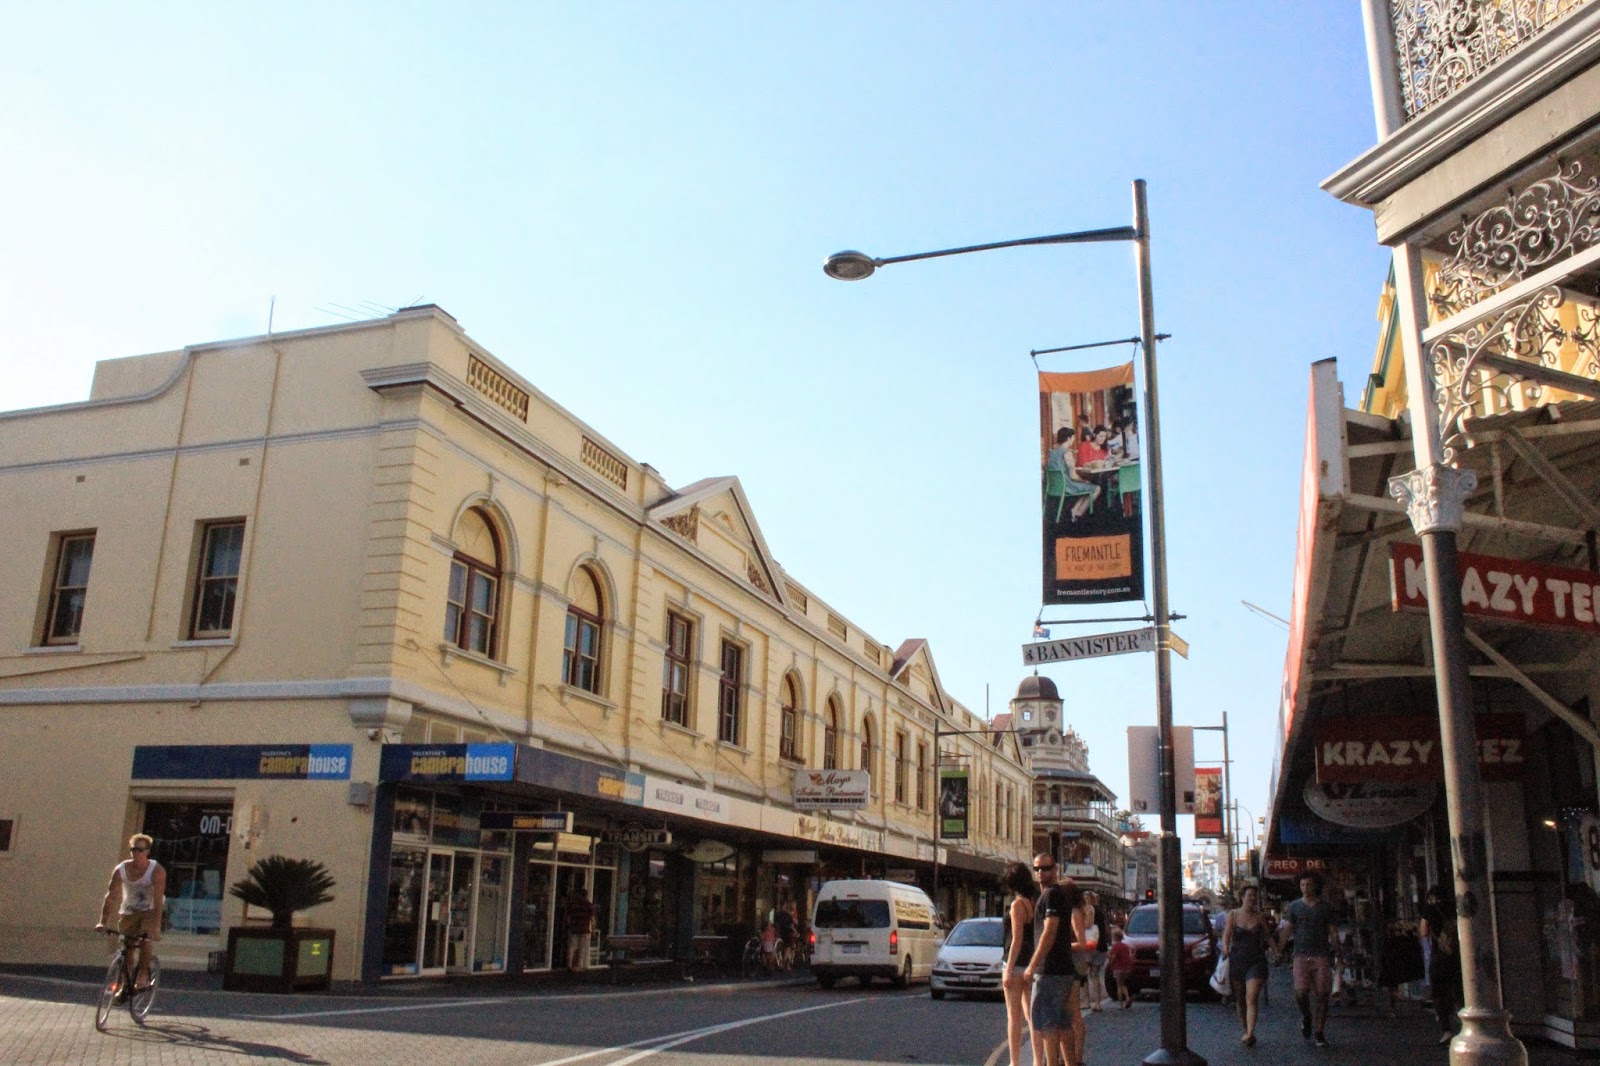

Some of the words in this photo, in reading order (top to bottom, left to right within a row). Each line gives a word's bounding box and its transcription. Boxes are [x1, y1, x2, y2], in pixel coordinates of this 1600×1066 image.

[1065, 543, 1121, 562] FREMANTLE
[1056, 587, 1131, 596] fremantlestory.com.au
[1404, 557, 1538, 615] KAZY
[1037, 633, 1139, 661] BANNISTER
[1141, 631, 1151, 640] ST
[1323, 740, 1433, 766] KRAZY
[607, 831, 660, 842] TRANSIT
